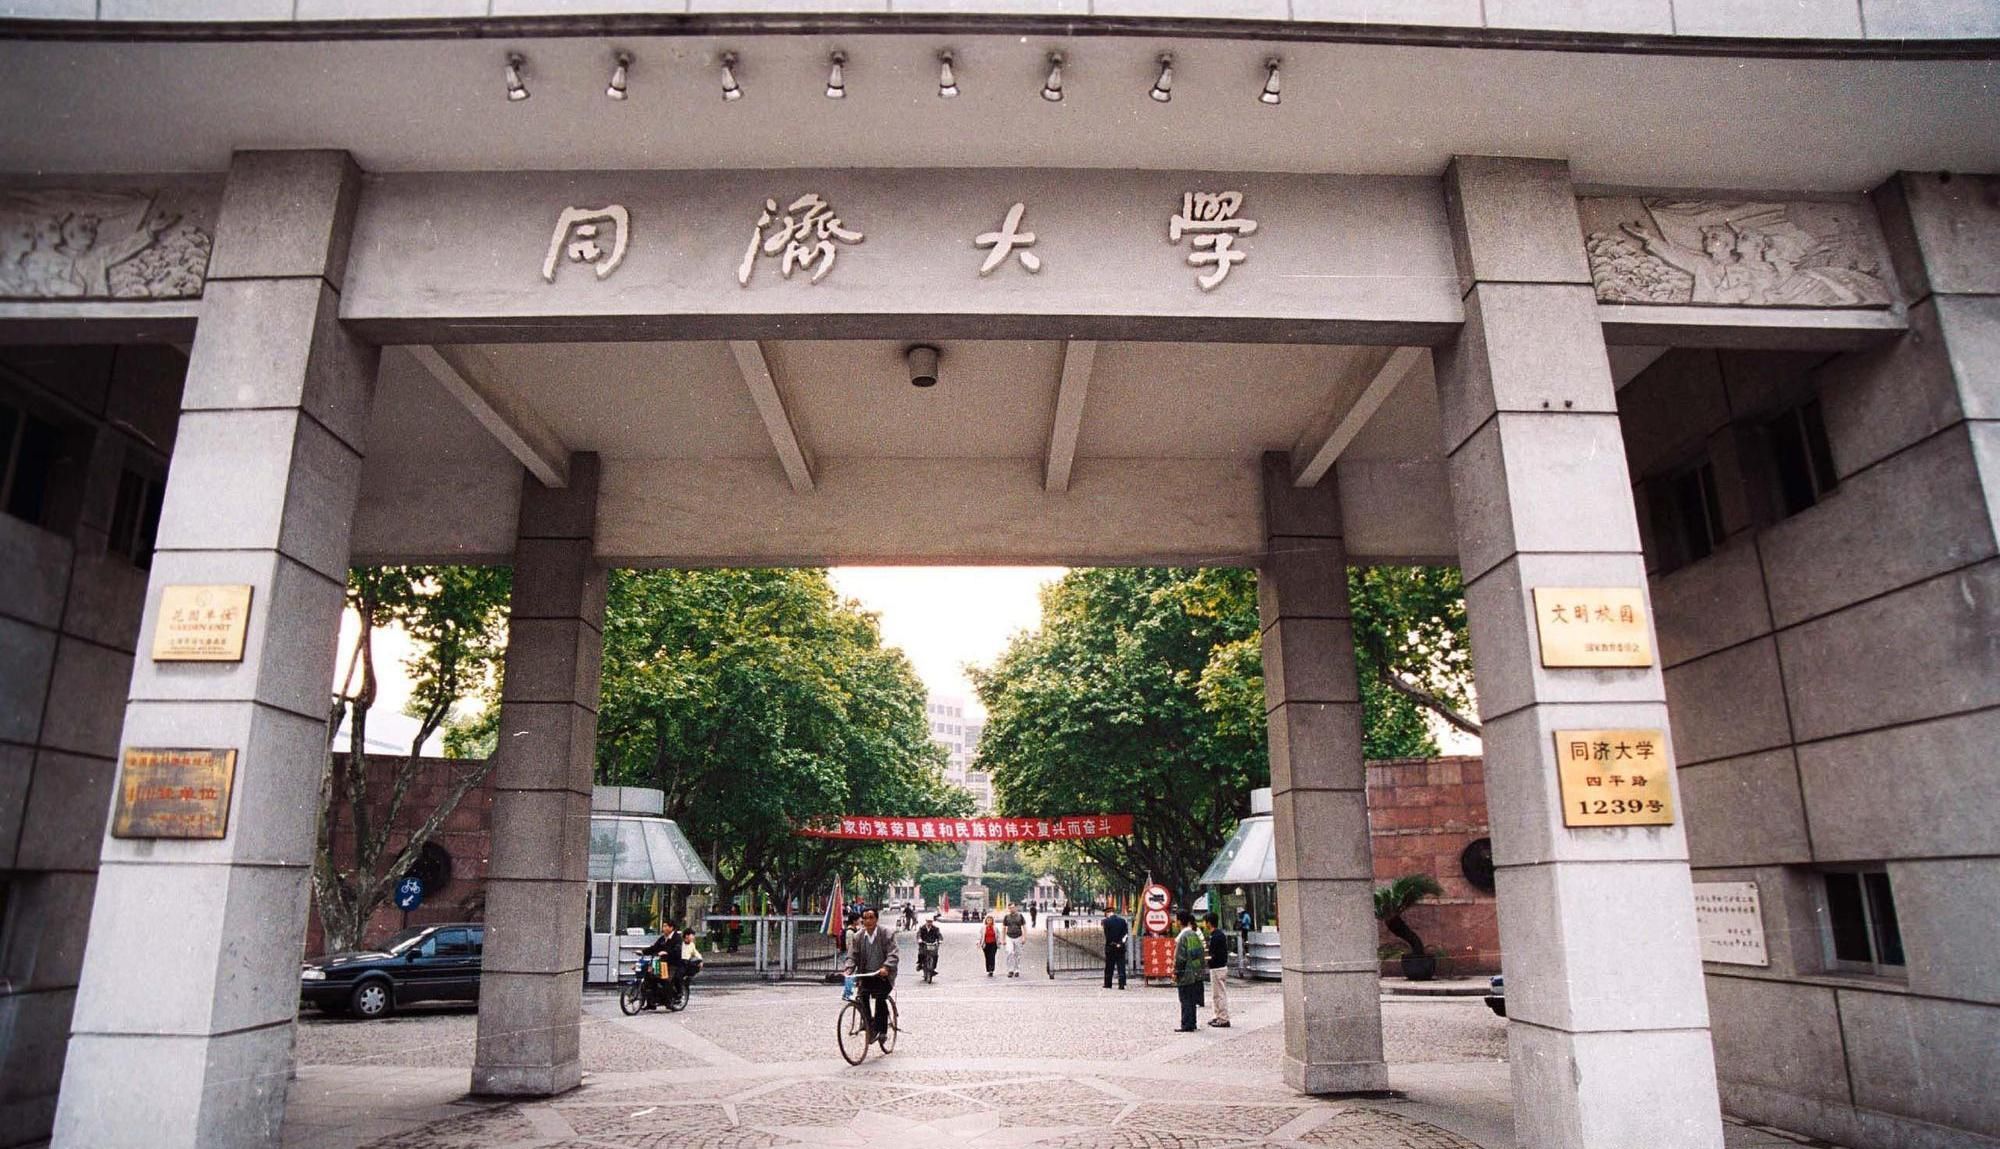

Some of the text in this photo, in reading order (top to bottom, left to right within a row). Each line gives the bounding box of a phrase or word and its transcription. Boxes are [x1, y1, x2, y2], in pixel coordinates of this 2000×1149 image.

[542, 191, 1258, 291] 同濟大學
[1551, 603, 1635, 624] 文明校园
[1570, 740, 1655, 761] 同济大学
[1586, 774, 1649, 788] 四平路
[1578, 799, 1664, 815] 1239号
